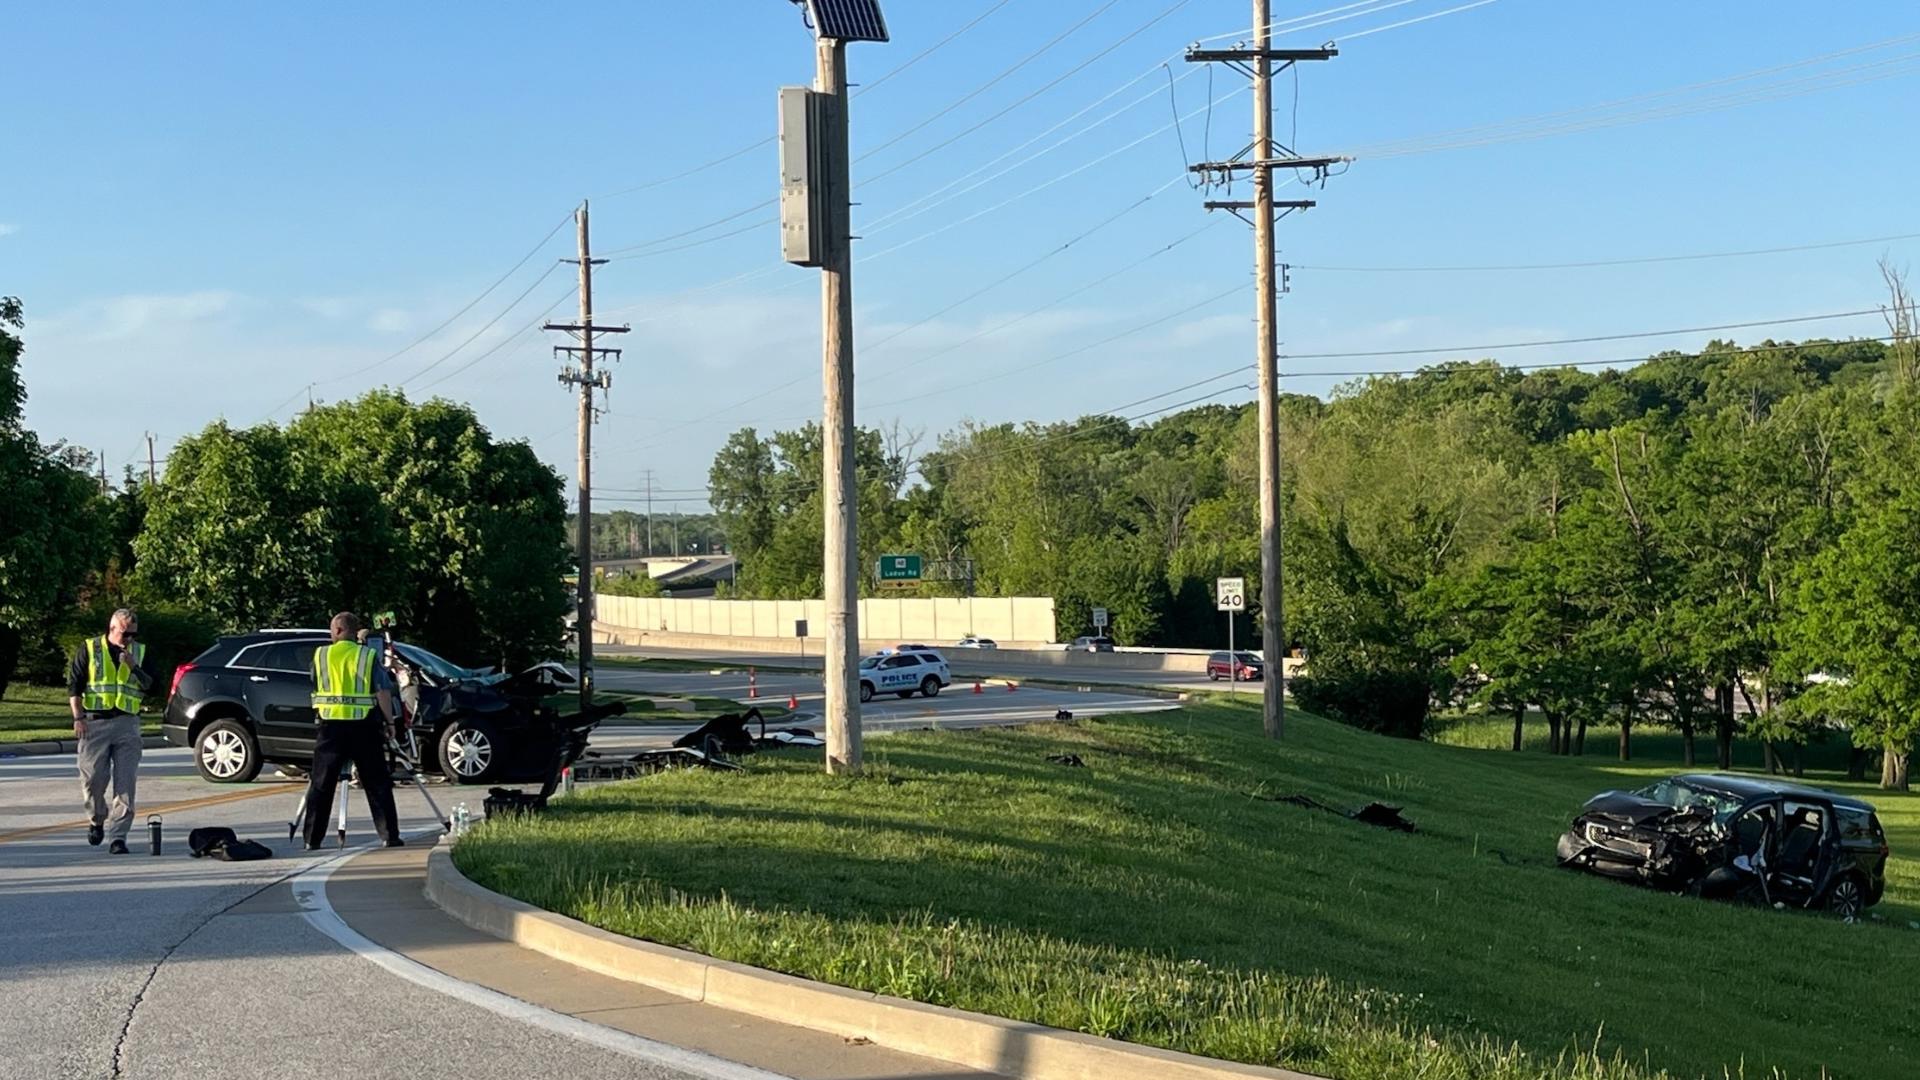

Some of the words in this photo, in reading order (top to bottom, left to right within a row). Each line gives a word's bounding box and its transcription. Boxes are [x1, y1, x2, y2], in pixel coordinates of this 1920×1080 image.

[908, 569, 917, 577] Rd
[1220, 594, 1242, 606] 40
[881, 673, 918, 683] POLICE
